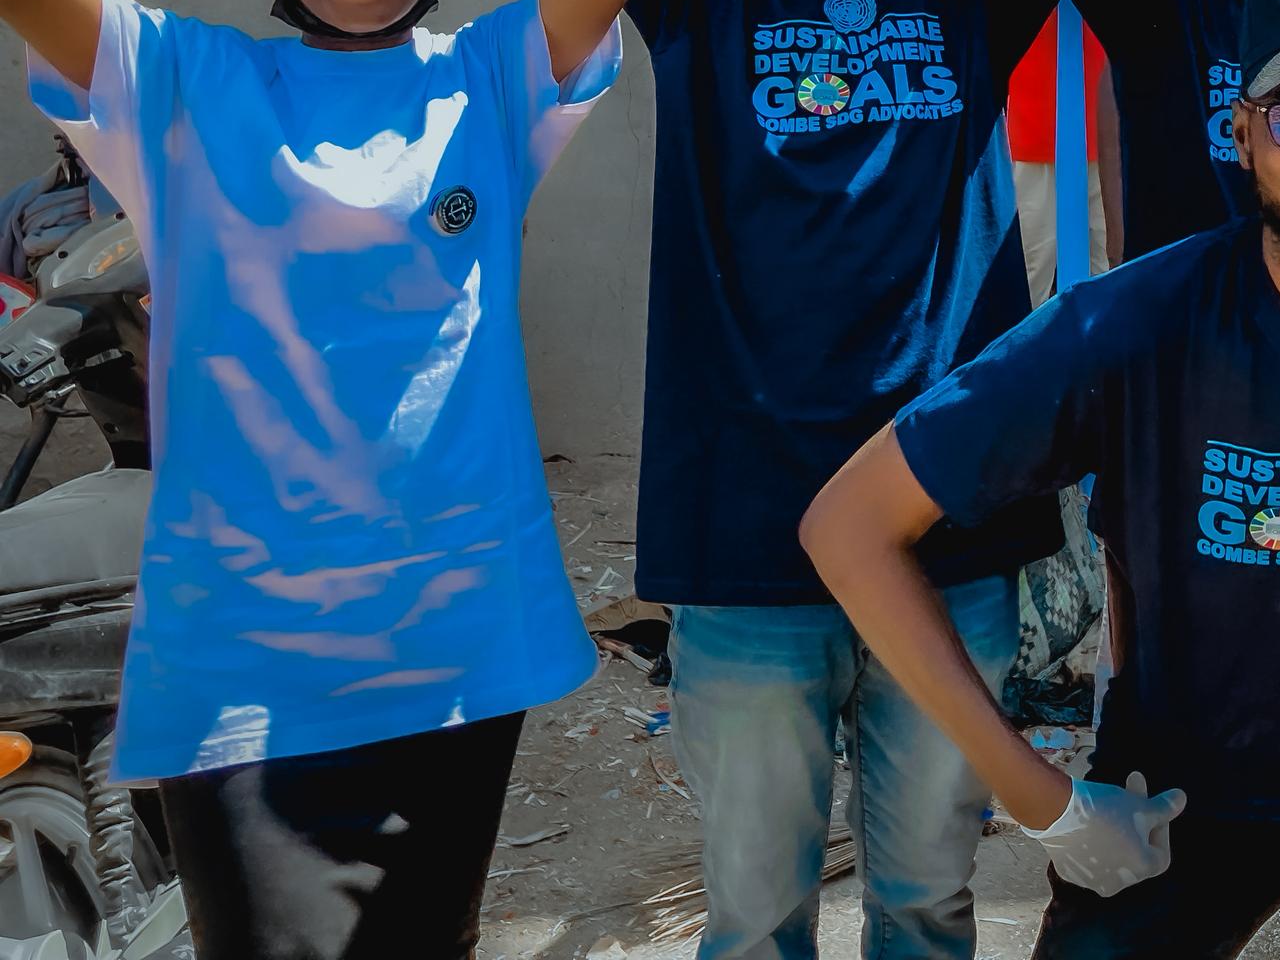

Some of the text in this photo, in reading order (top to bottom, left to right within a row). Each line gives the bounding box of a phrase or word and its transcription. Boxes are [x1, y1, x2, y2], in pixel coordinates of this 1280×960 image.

[754, 19, 944, 54] SUSTAINABLE
[754, 42, 945, 75] DEVELOPMENT
[752, 64, 958, 118] GOALS
[826, 109, 864, 129] SDG
[868, 98, 963, 122] ADVOCATES
[1196, 538, 1270, 566] GOMBE
